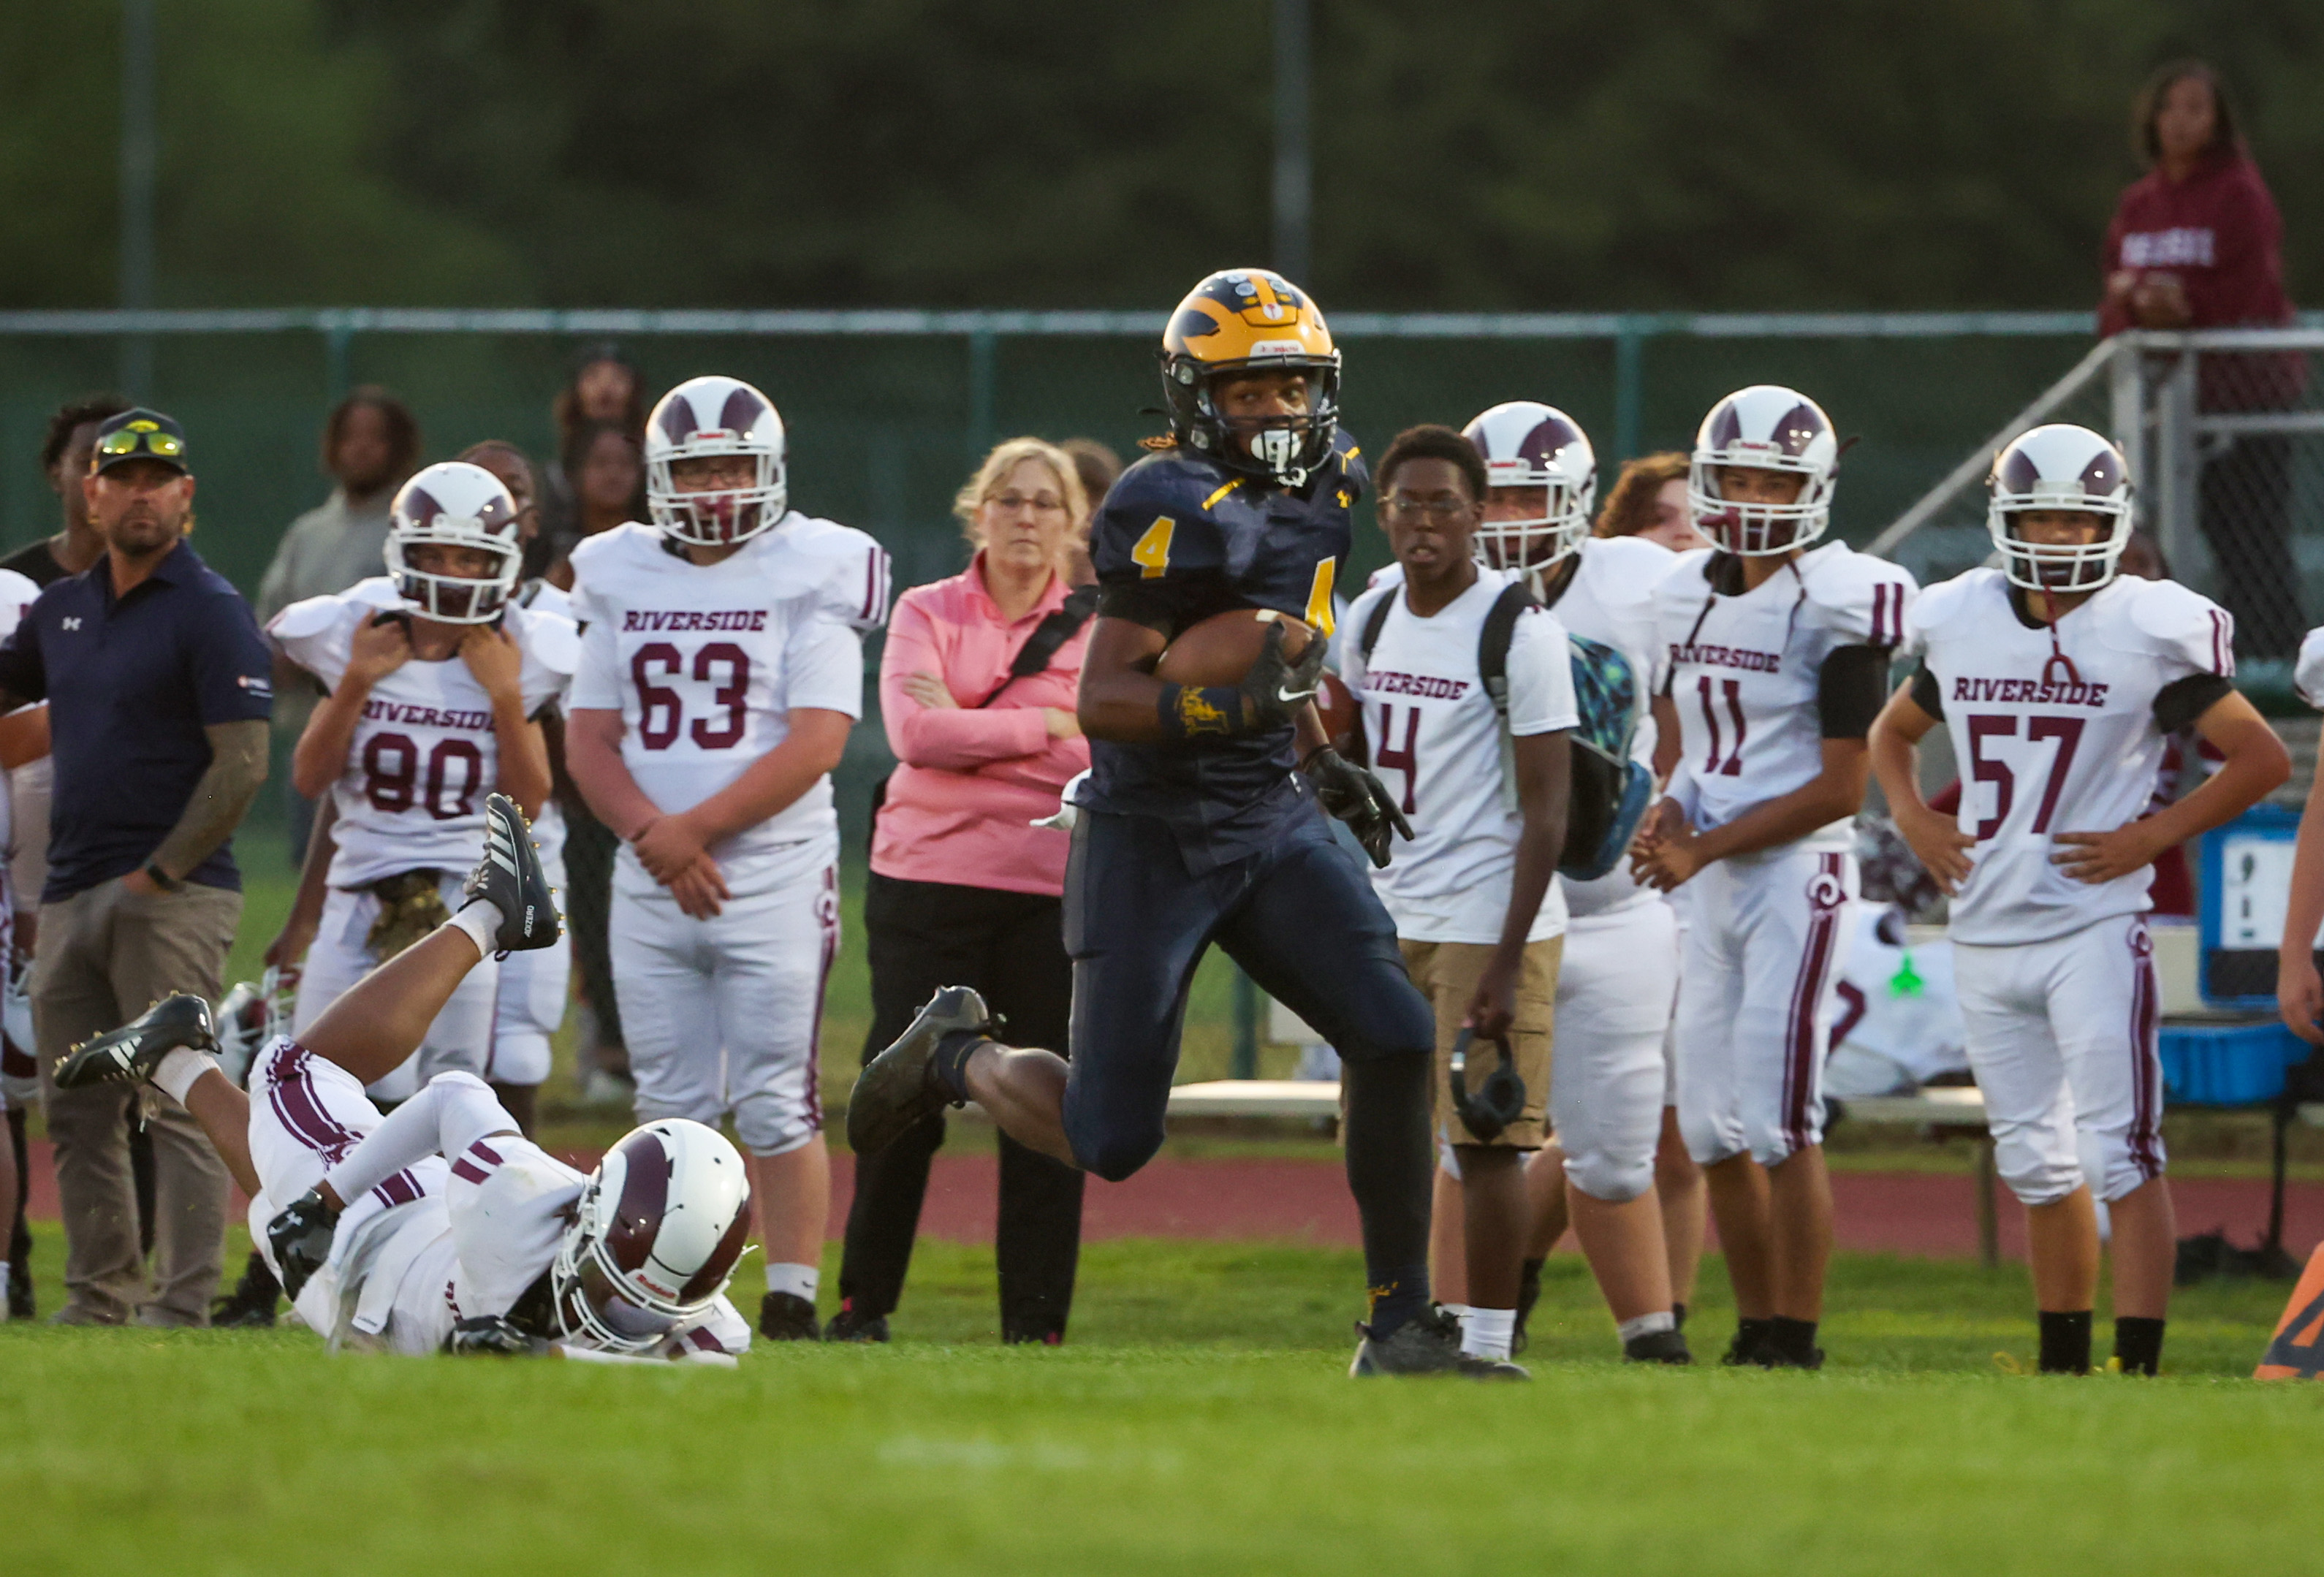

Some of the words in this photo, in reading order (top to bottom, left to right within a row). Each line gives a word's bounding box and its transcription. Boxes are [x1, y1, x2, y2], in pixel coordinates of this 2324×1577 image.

[1131, 515, 1176, 579] 4
[623, 610, 767, 631] RIVERSIDE
[1669, 641, 1781, 674] RIVERSIDE
[631, 642, 750, 750] 63
[1698, 675, 1747, 777] 11
[1953, 677, 2108, 707] RIVERSIDE
[363, 732, 483, 821] 80
[1377, 703, 1421, 815] 4
[1967, 714, 2086, 841] 57
